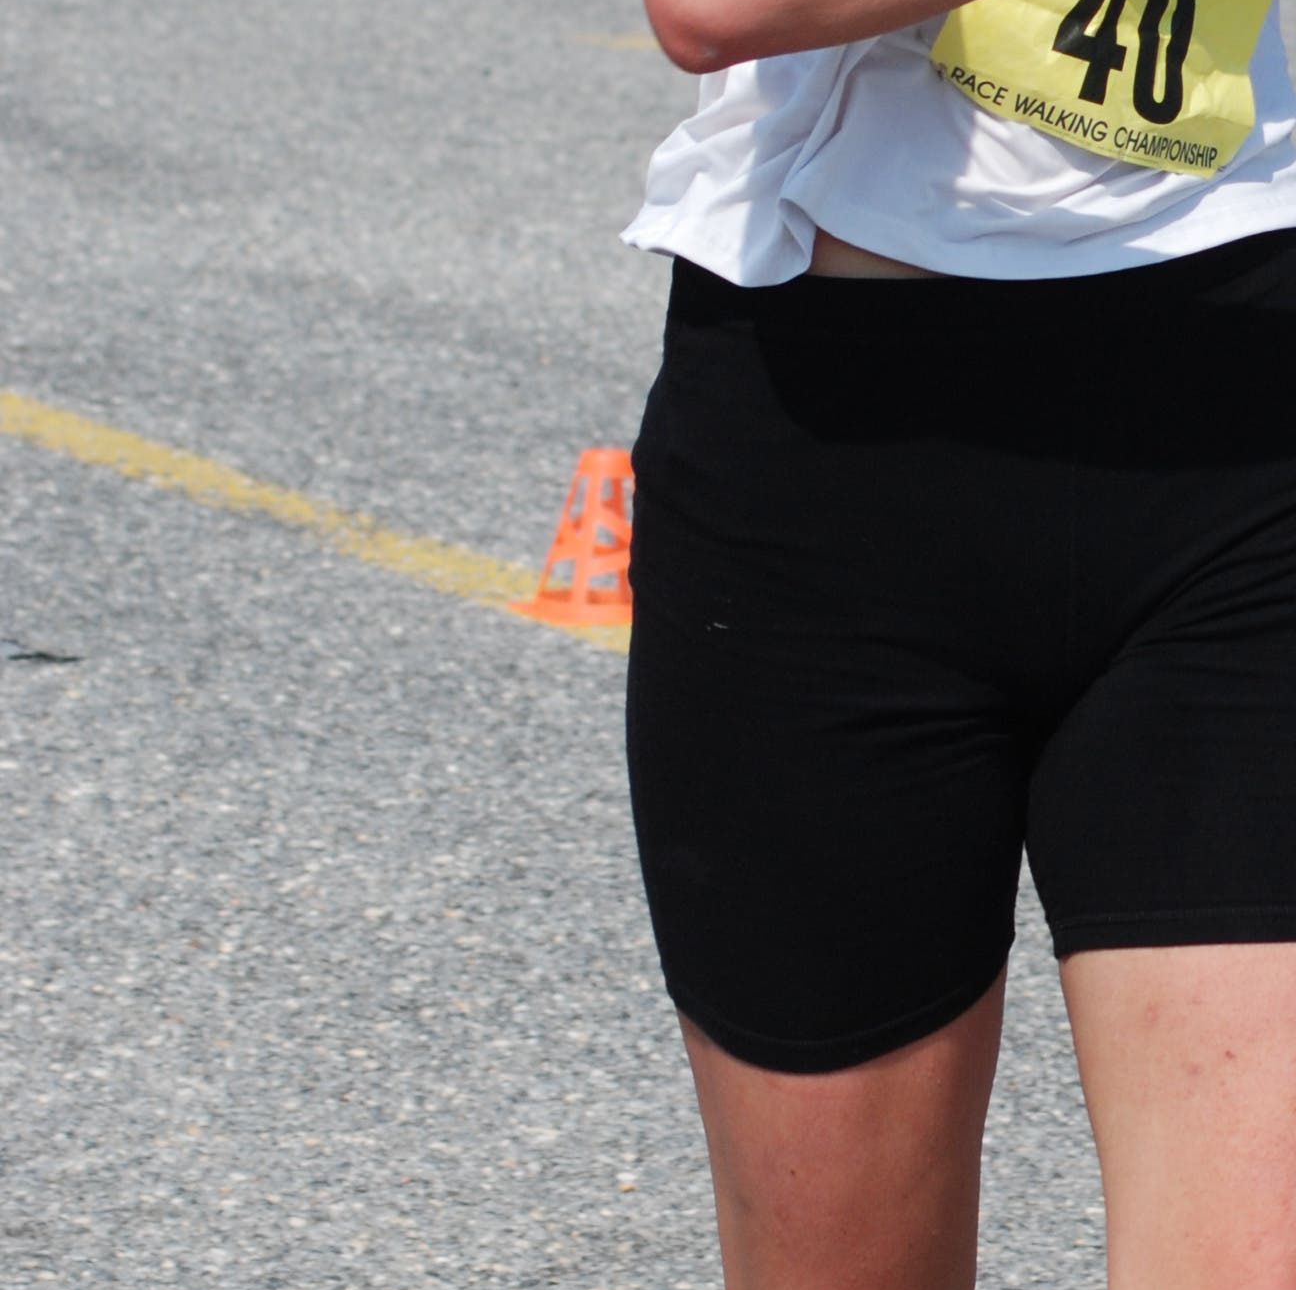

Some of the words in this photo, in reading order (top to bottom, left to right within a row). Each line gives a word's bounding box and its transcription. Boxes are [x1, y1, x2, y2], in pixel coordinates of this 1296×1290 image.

[950, 66, 1009, 106] RACE
[1014, 93, 1108, 142] WALKING
[1113, 125, 1218, 169] CHAMPIONSHIP
